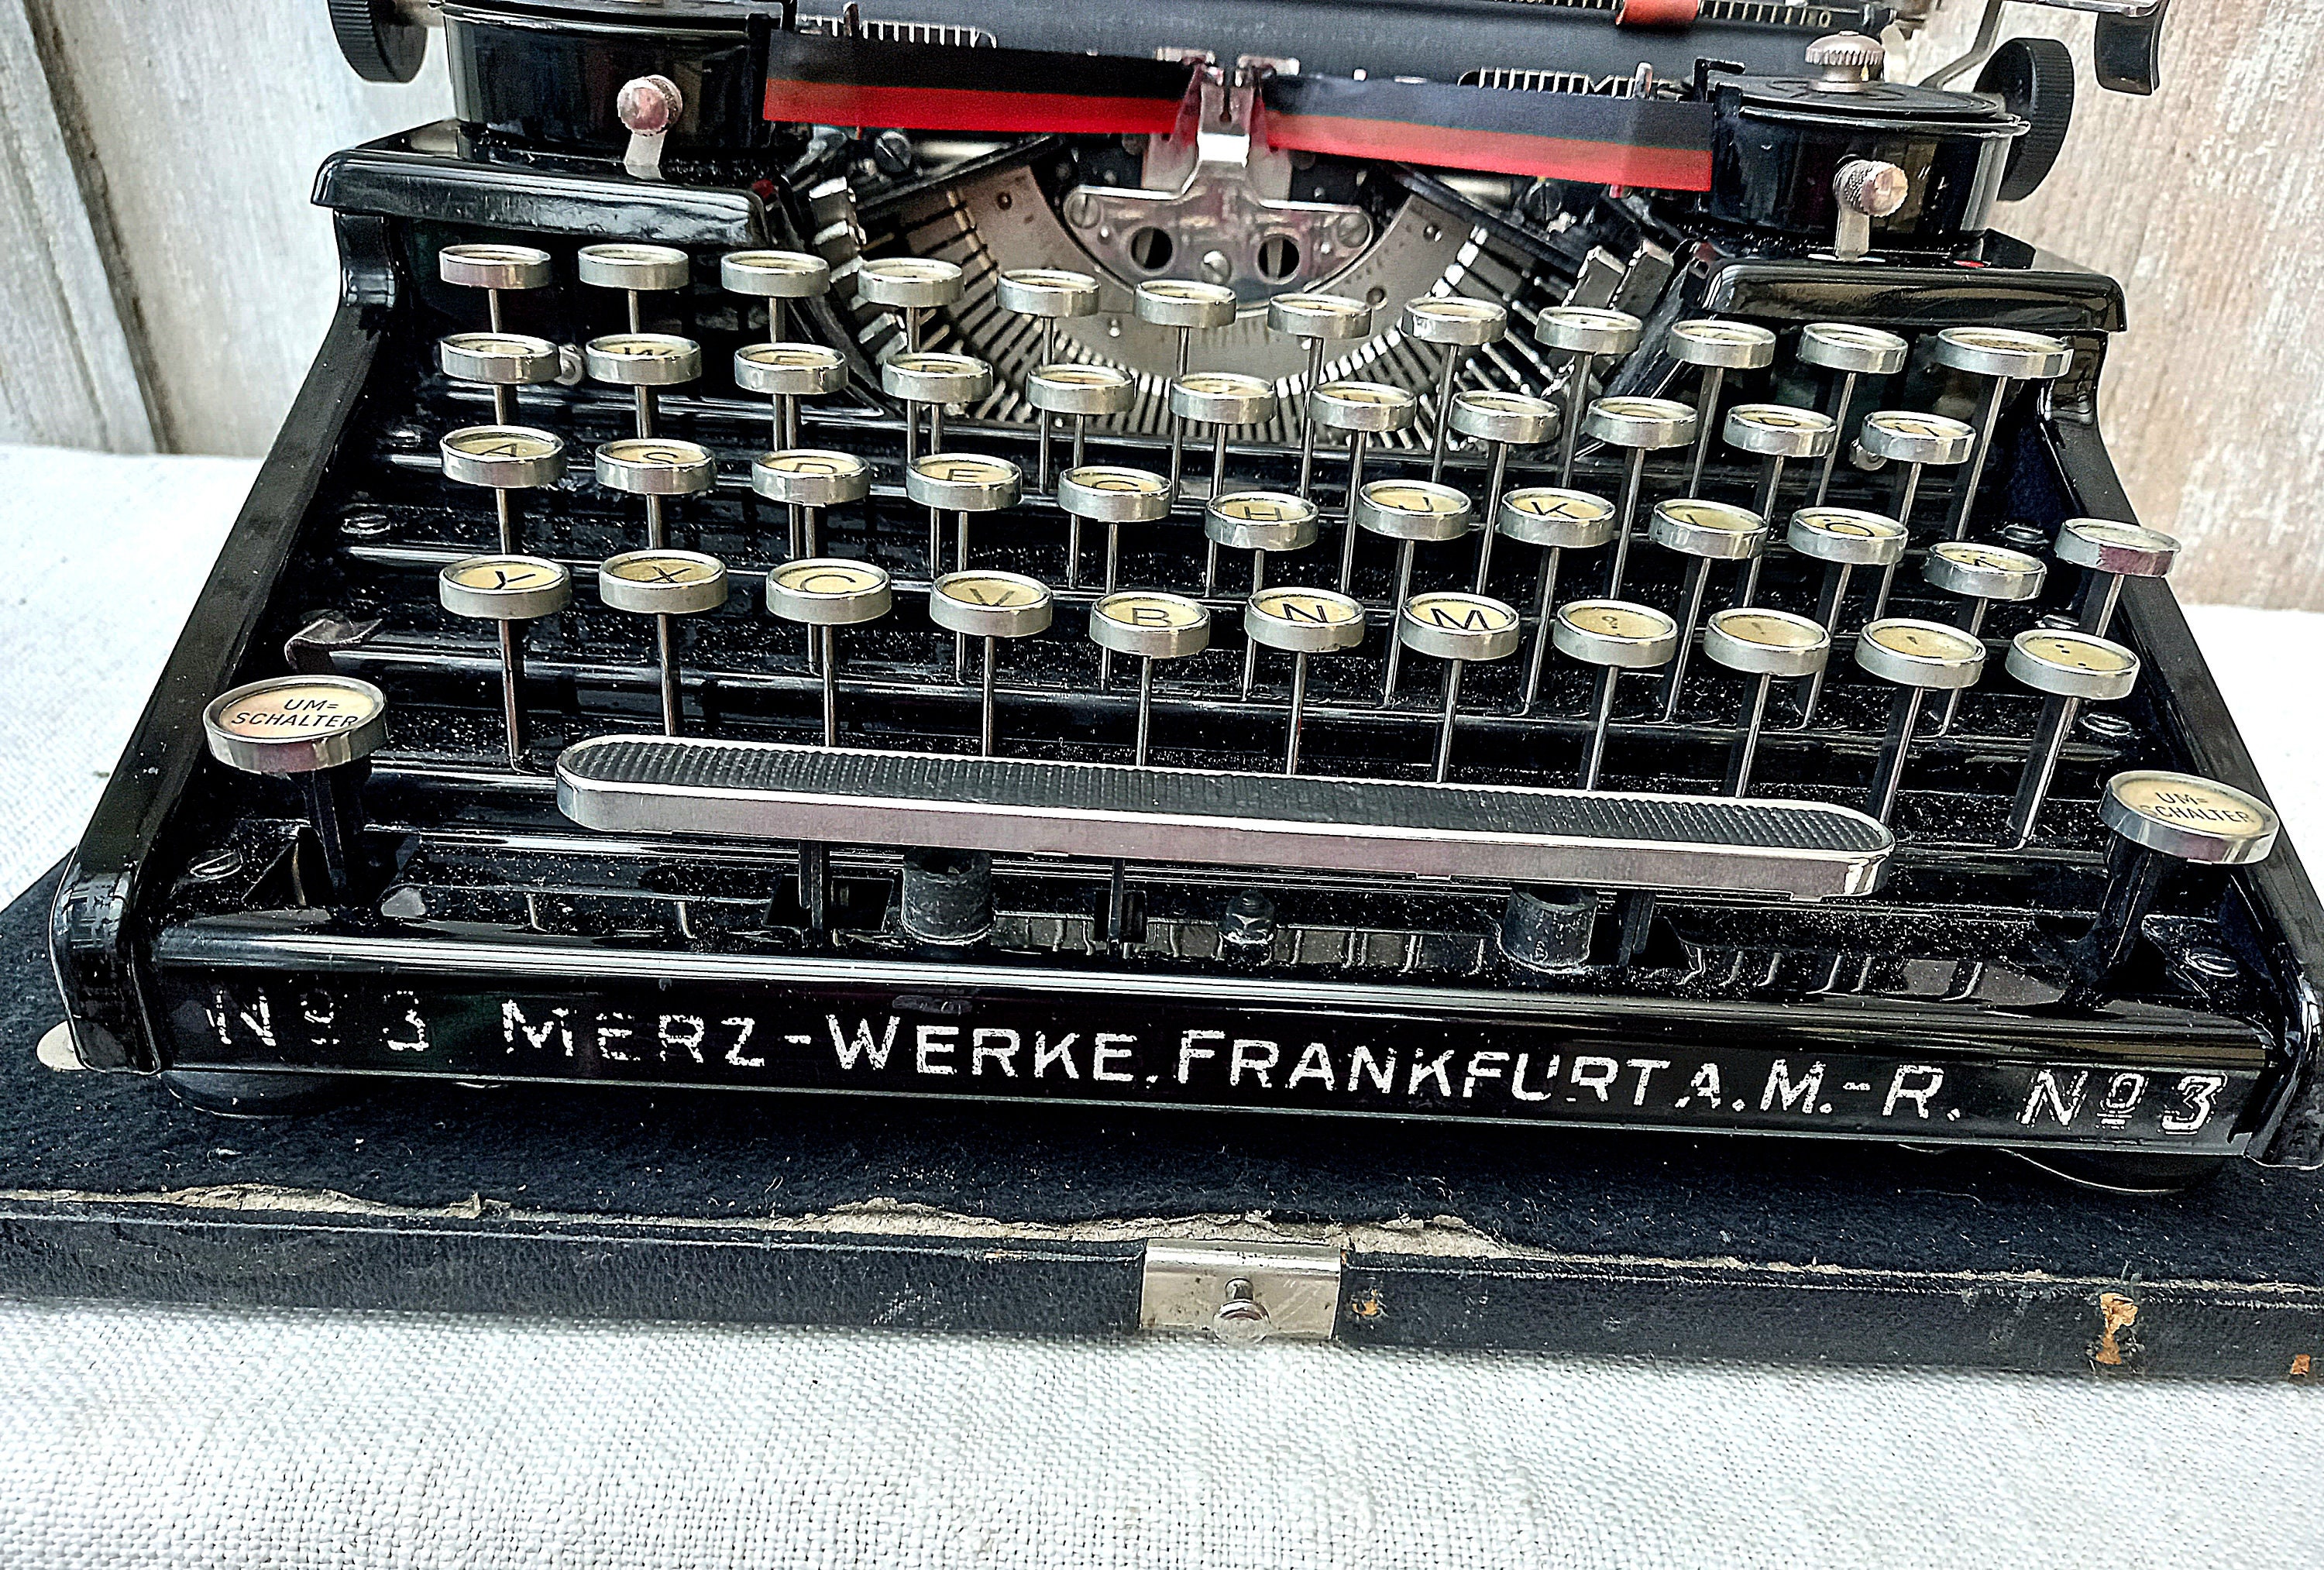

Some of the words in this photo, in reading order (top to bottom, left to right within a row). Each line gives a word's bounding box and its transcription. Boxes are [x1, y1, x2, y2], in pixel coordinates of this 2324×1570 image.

[493, 570, 536, 589] Y
[969, 587, 1016, 606] V
[1131, 607, 1174, 627] B
[1282, 603, 1329, 624] N
[1430, 608, 1491, 631] M
[230, 712, 359, 728] SCHALTER
[2138, 804, 2257, 823] SCHALTER
[2160, 1072, 2229, 1135] 3
